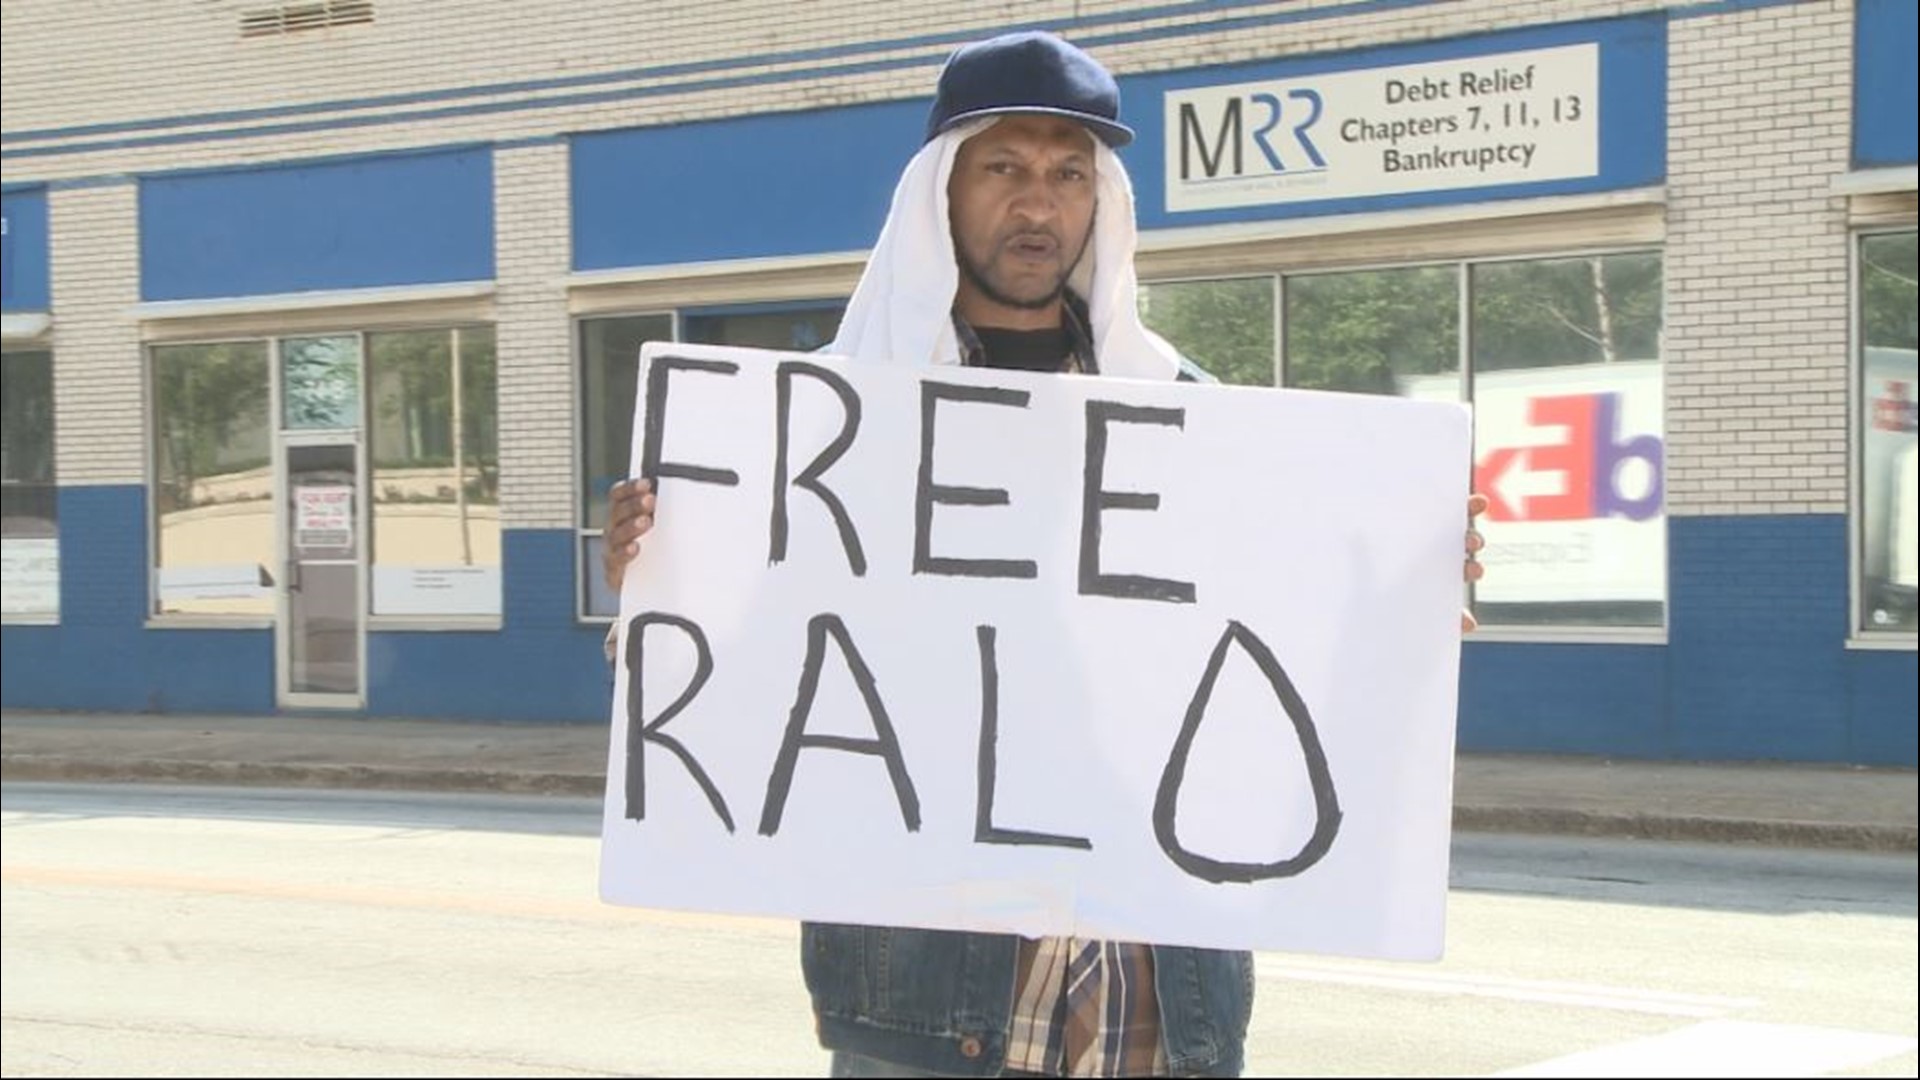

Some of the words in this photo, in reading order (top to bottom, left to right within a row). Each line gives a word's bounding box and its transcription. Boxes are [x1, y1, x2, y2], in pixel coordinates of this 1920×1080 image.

[1385, 79, 1450, 104] Debt
[1460, 65, 1536, 96] Relief
[1180, 88, 1328, 180] MRR
[1340, 116, 1457, 144] Chapters
[1468, 106, 1490, 131] 7,
[1502, 101, 1540, 128] 11,
[1553, 96, 1582, 121] 13
[1383, 141, 1537, 173] Bankruptcy
[640, 356, 1197, 604] FREE
[624, 610, 1344, 884] RALO
